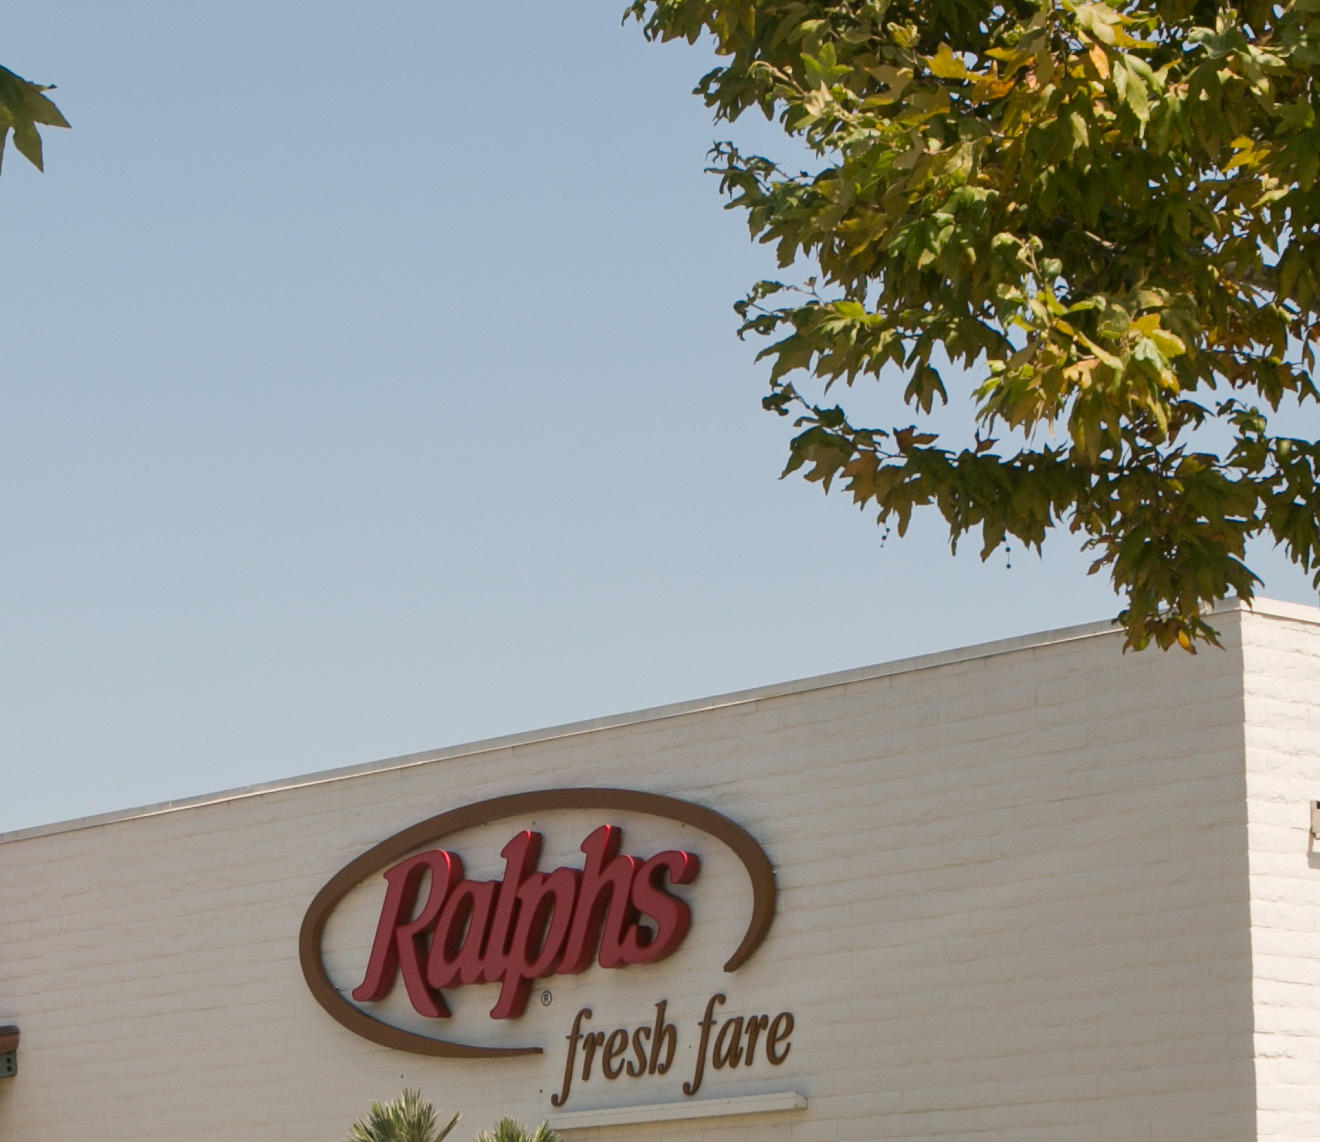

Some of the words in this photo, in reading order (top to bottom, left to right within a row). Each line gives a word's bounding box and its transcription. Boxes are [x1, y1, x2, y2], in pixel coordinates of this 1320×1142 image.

[351, 823, 700, 1019] Ralphs
[549, 999, 678, 1107] fresh
[682, 992, 796, 1096] fare
